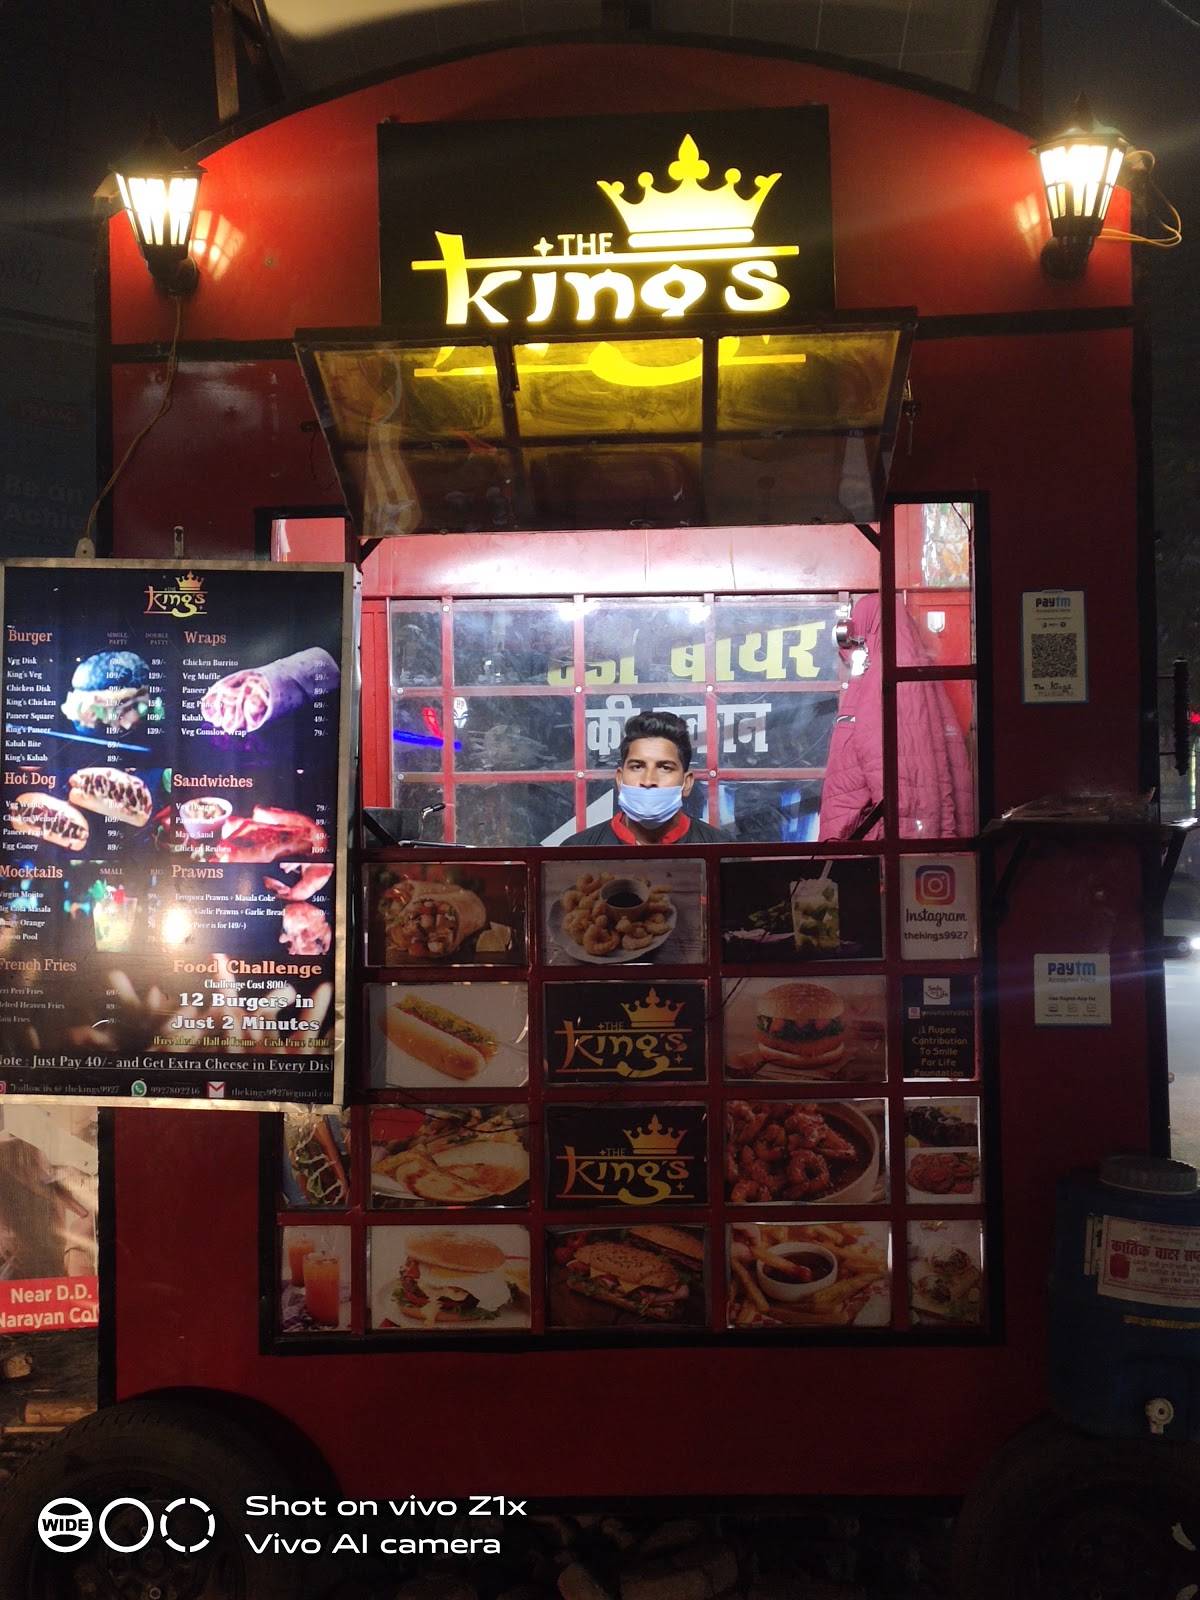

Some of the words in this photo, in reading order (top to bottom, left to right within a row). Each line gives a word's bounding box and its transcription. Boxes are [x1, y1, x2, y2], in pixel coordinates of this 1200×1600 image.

[556, 232, 614, 256] THE
[8, 629, 53, 645] Burger
[184, 631, 227, 646] Wraps
[7, 671, 27, 679] King's
[182, 673, 196, 681] Veg
[182, 686, 205, 694] Paneer
[6, 698, 28, 706] King's
[182, 700, 195, 709] Egg
[6, 712, 30, 720] Paneer
[31, 712, 55, 721] Square
[181, 728, 195, 737] Veg
[5, 754, 25, 763] King's
[5, 772, 28, 784] Hot
[30, 772, 56, 788] Dog
[173, 774, 253, 788] Sandwiches
[3, 843, 15, 851] Egg
[0, 865, 63, 879] Mocktails
[172, 865, 224, 879] Prawns
[215, 908, 239, 916] Prawns
[906, 908, 968, 927] Instagram
[20, 919, 45, 927] Orange
[904, 931, 968, 941] thekings9927
[44, 959, 77, 971] Fries
[173, 960, 219, 974] Food
[227, 961, 322, 978] Challenge
[204, 979, 246, 991] Challenge
[247, 980, 265, 989] Cost
[179, 993, 204, 1007] 12
[212, 993, 289, 1011] Burgers
[295, 994, 314, 1008] in
[171, 1016, 215, 1030] Just
[222, 1016, 235, 1030] 2
[241, 1016, 320, 1031] Minutes
[31, 1054, 55, 1069] Just
[60, 1055, 82, 1069] Pay
[84, 1056, 113, 1067] 40/-
[116, 1057, 139, 1068] and
[143, 1057, 164, 1069] Get
[168, 1058, 201, 1069] Extra
[205, 1058, 249, 1070] Cheese
[253, 1059, 265, 1070] in
[269, 1060, 306, 1073] Every
[309, 1061, 332, 1071] Dis
[11, 1288, 52, 1304] Near
[57, 1284, 92, 1300] D.D.
